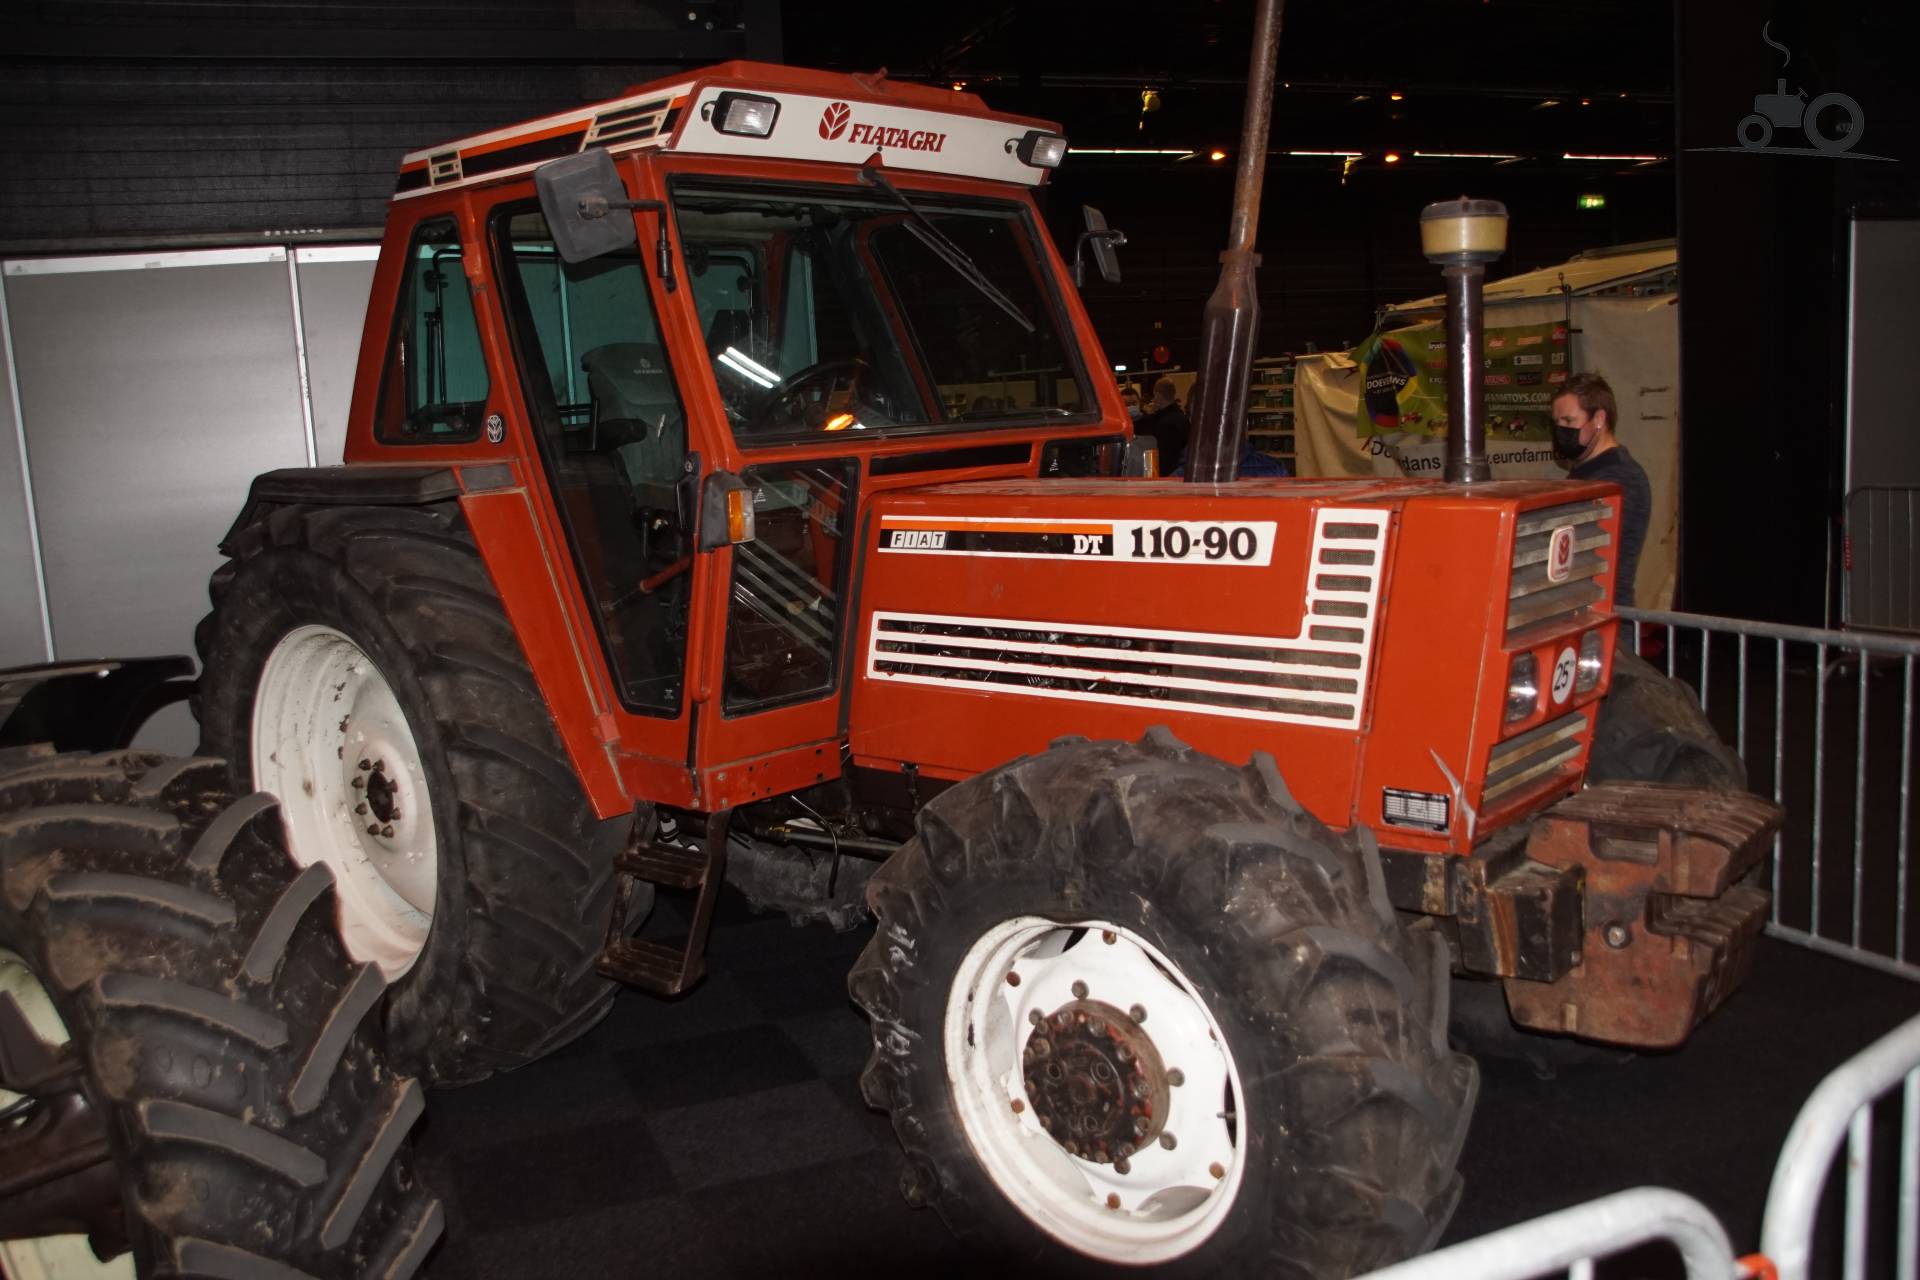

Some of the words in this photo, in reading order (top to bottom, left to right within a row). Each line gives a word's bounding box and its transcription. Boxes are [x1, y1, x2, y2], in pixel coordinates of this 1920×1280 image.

[848, 123, 947, 152] FIATAGRI
[891, 530, 947, 549] FIAT
[1073, 534, 1103, 555] DT
[1131, 526, 1258, 561] 110-90
[1554, 660, 1569, 692] 25
